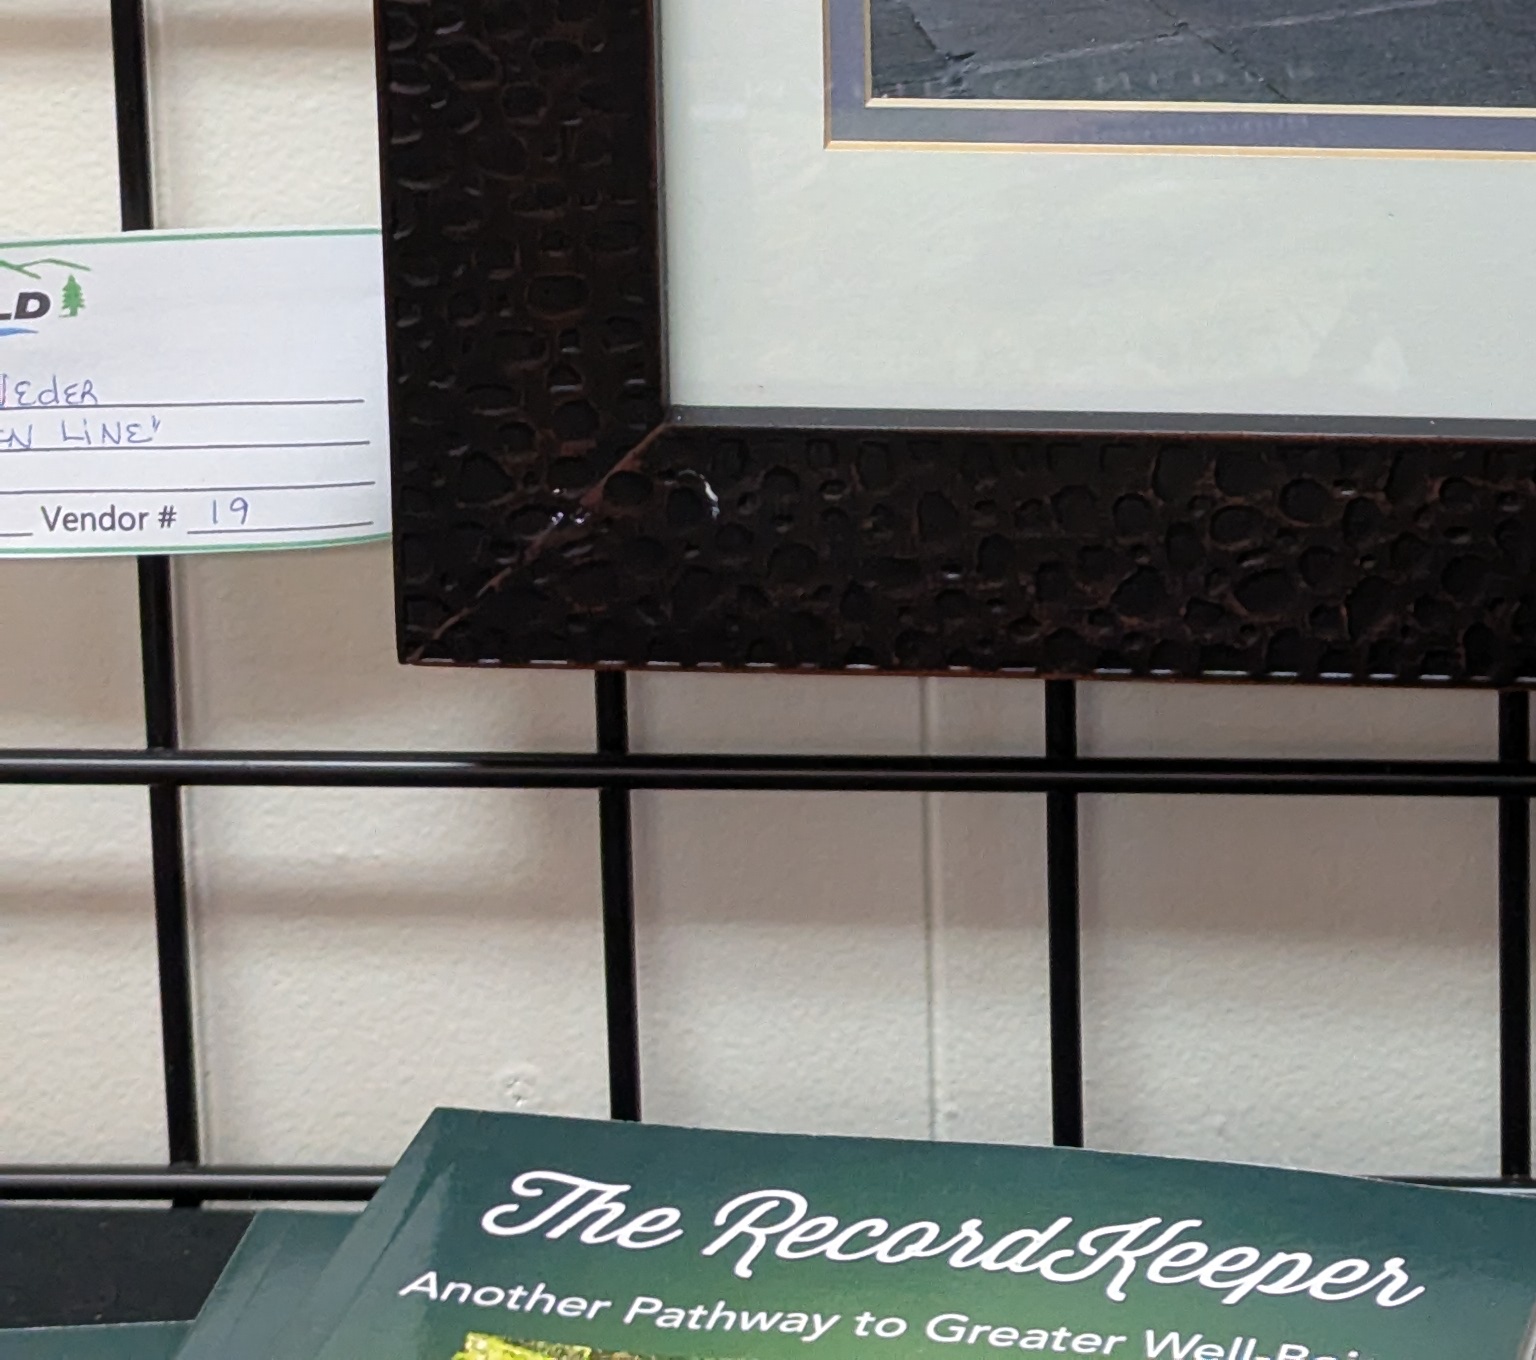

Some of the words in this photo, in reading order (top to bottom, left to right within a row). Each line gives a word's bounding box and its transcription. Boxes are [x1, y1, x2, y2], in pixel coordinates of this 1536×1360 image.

[41, 504, 150, 533] Vendor
[157, 504, 178, 529] #
[211, 496, 250, 526] 19
[481, 1169, 684, 1250] The
[702, 1188, 1426, 1308] RecordKeeper
[398, 1269, 613, 1322] Another
[623, 1295, 841, 1342] Pathway
[854, 1309, 908, 1339] to
[925, 1312, 1128, 1357] Greater
